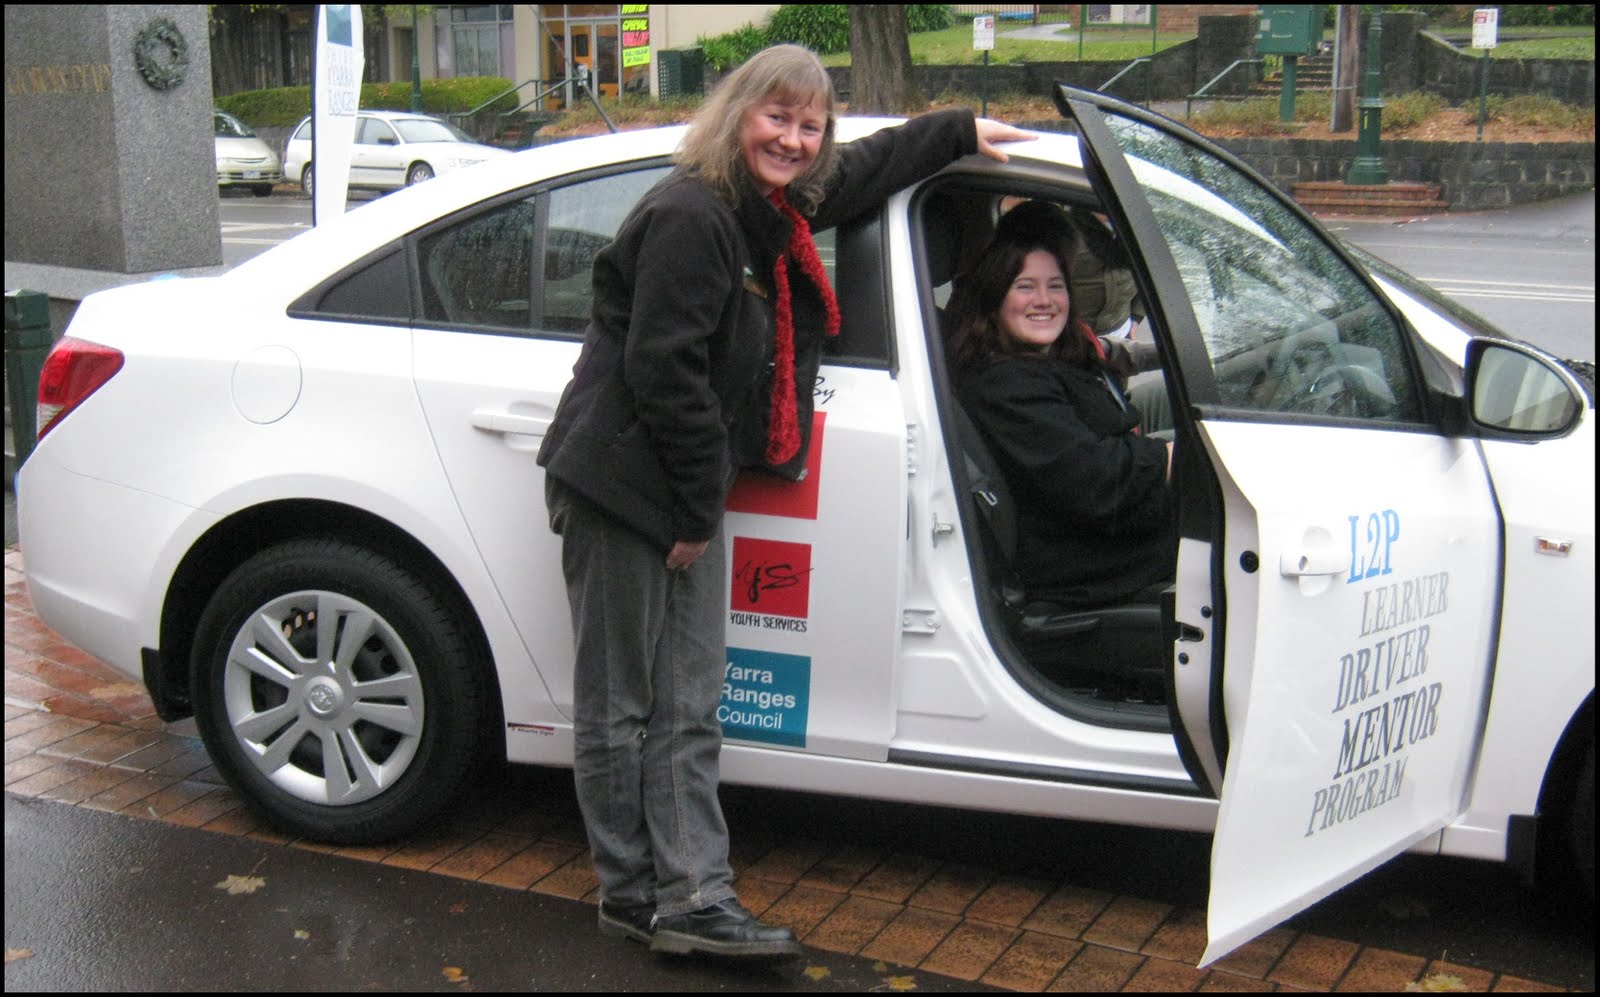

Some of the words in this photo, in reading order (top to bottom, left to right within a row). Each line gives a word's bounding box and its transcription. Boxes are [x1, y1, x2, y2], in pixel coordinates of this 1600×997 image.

[1346, 509, 1400, 584] L2P
[730, 612, 760, 628] YOUTH
[763, 616, 808, 632] SERVICES
[1359, 571, 1449, 638] LEARNER
[720, 683, 796, 709] Ranges
[725, 662, 773, 684] Yarra
[1331, 624, 1431, 714] DRIVER
[716, 705, 783, 729] Council
[1333, 682, 1443, 780] MENTOR
[1304, 755, 1409, 838] PROGRAM
